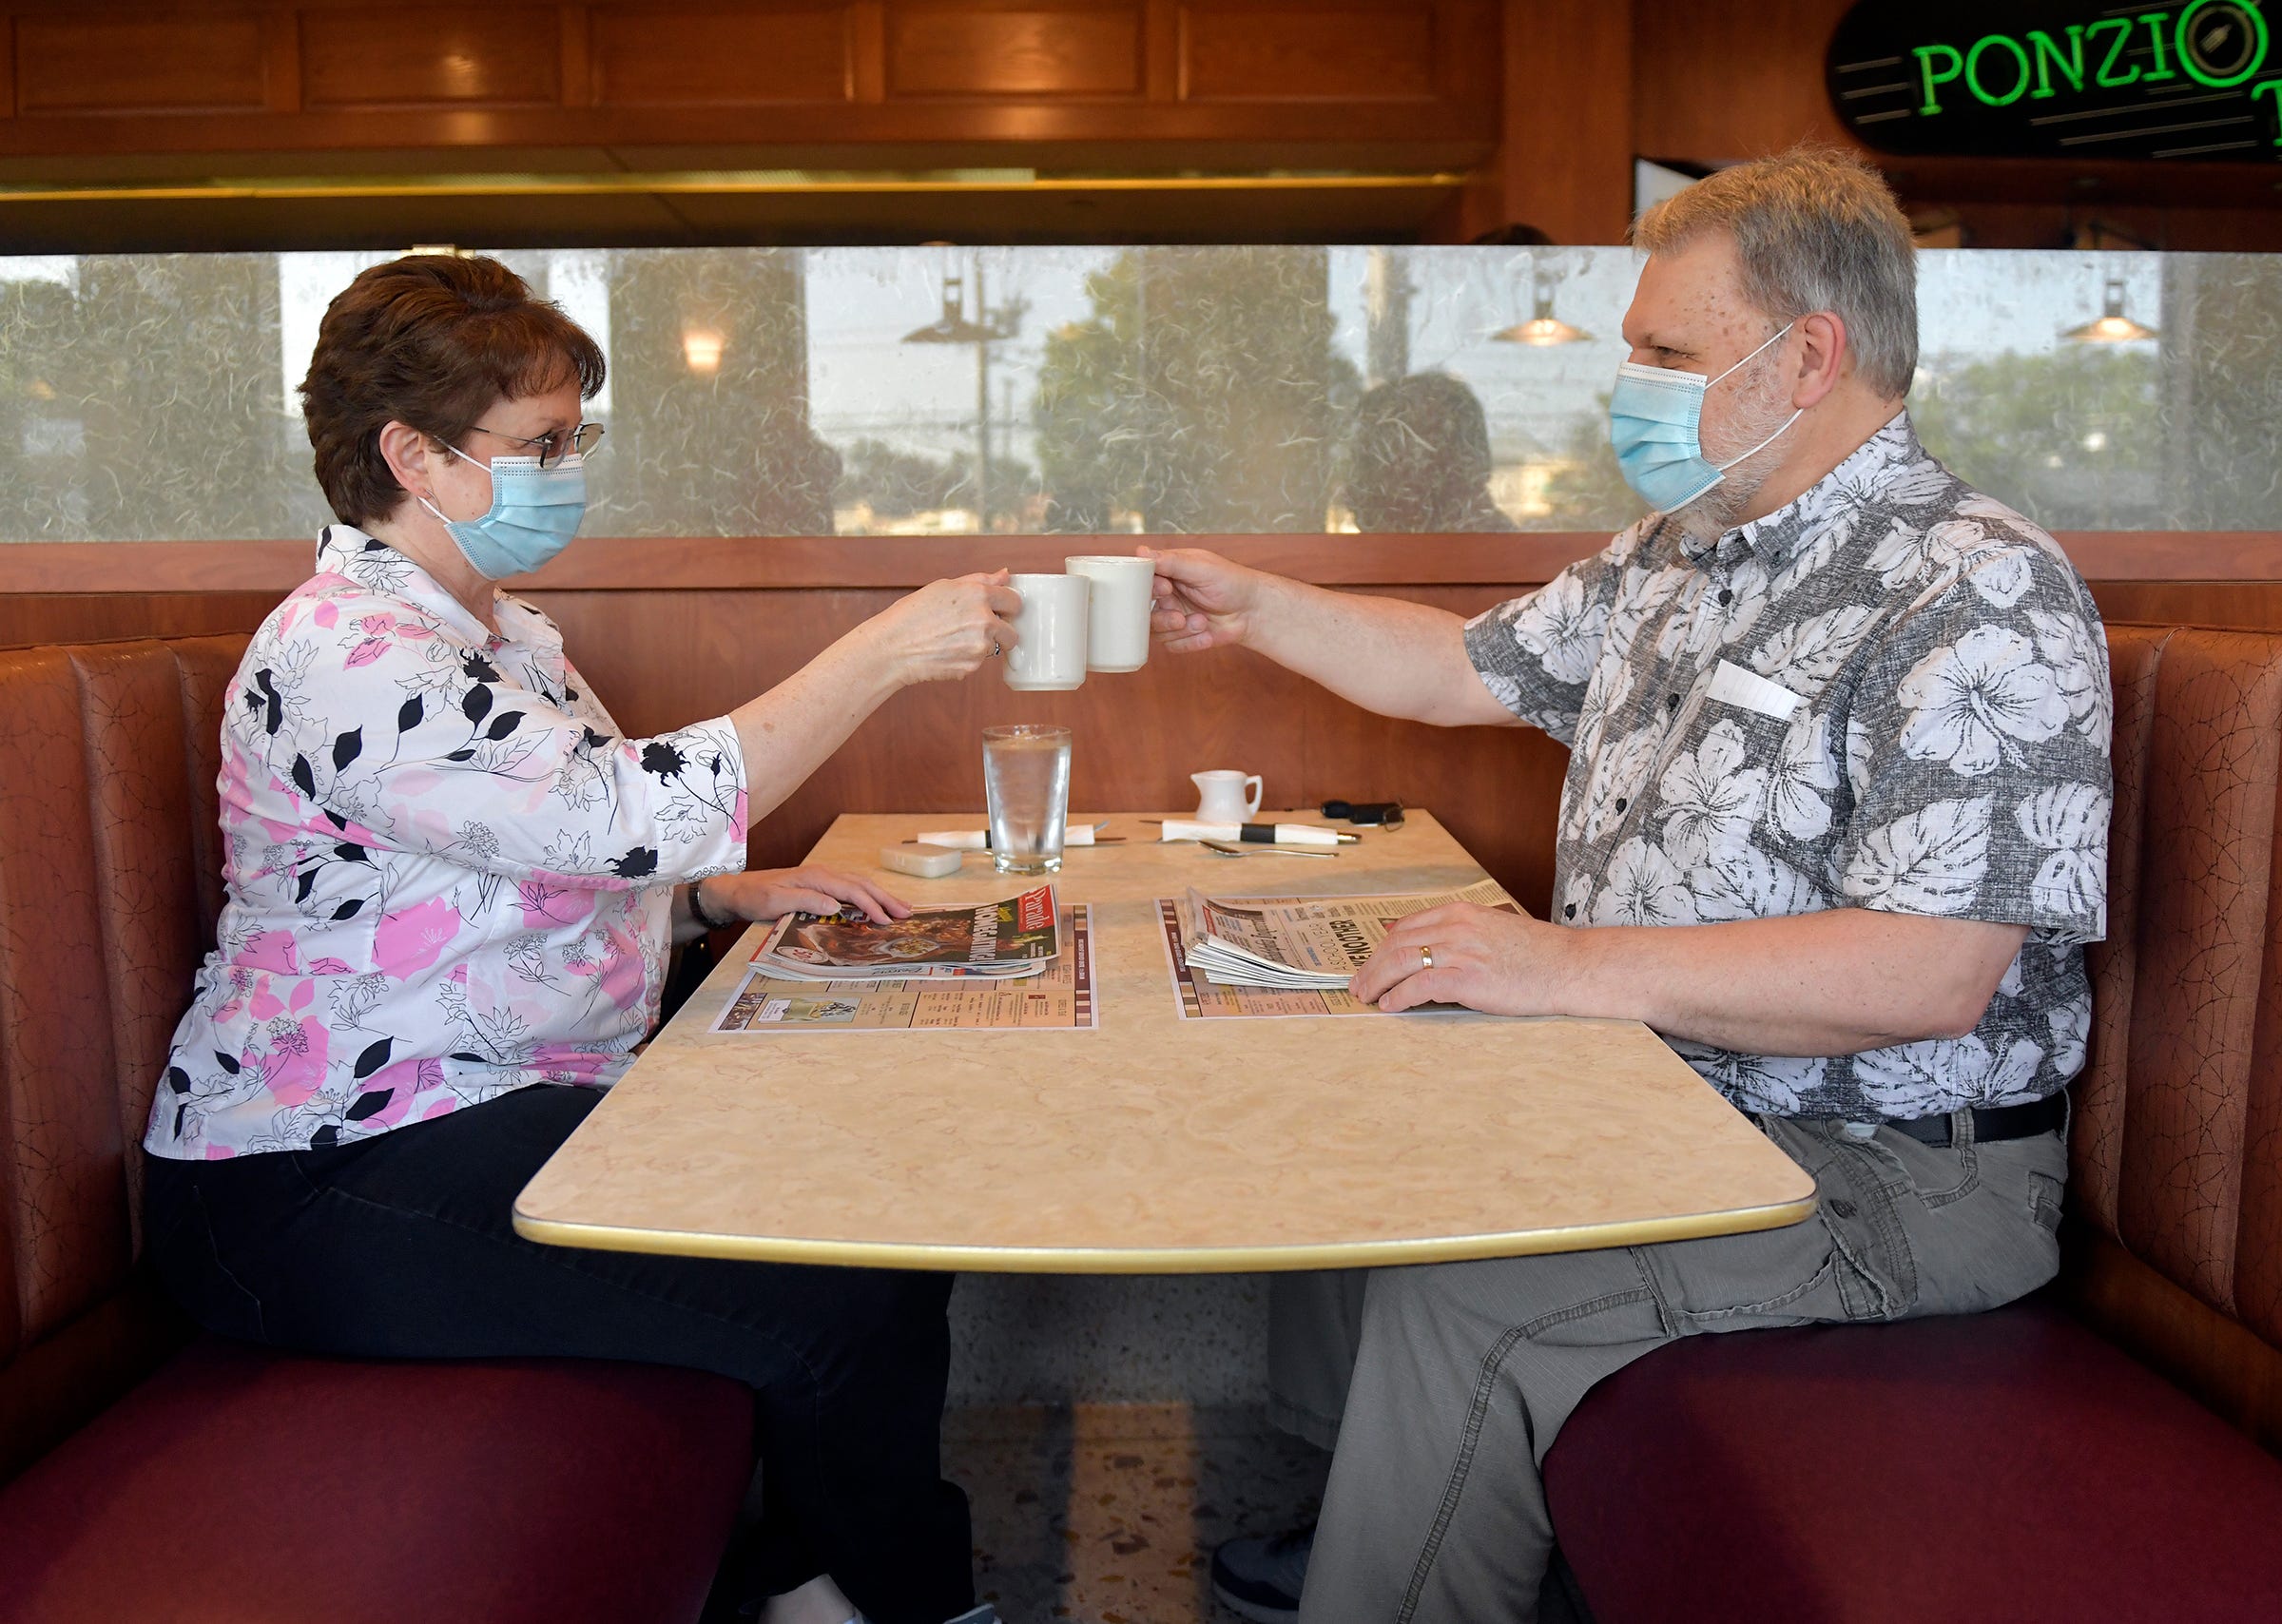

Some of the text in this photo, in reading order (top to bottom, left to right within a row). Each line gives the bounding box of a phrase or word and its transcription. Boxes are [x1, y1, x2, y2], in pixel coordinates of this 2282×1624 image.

[1911, 0, 2270, 116] PONZIO
[1025, 887, 1051, 930] Parade
[969, 904, 999, 961] HOMEGATING!
[1318, 938, 1346, 965] SCHOOL
[1329, 919, 1364, 942] OTHER
